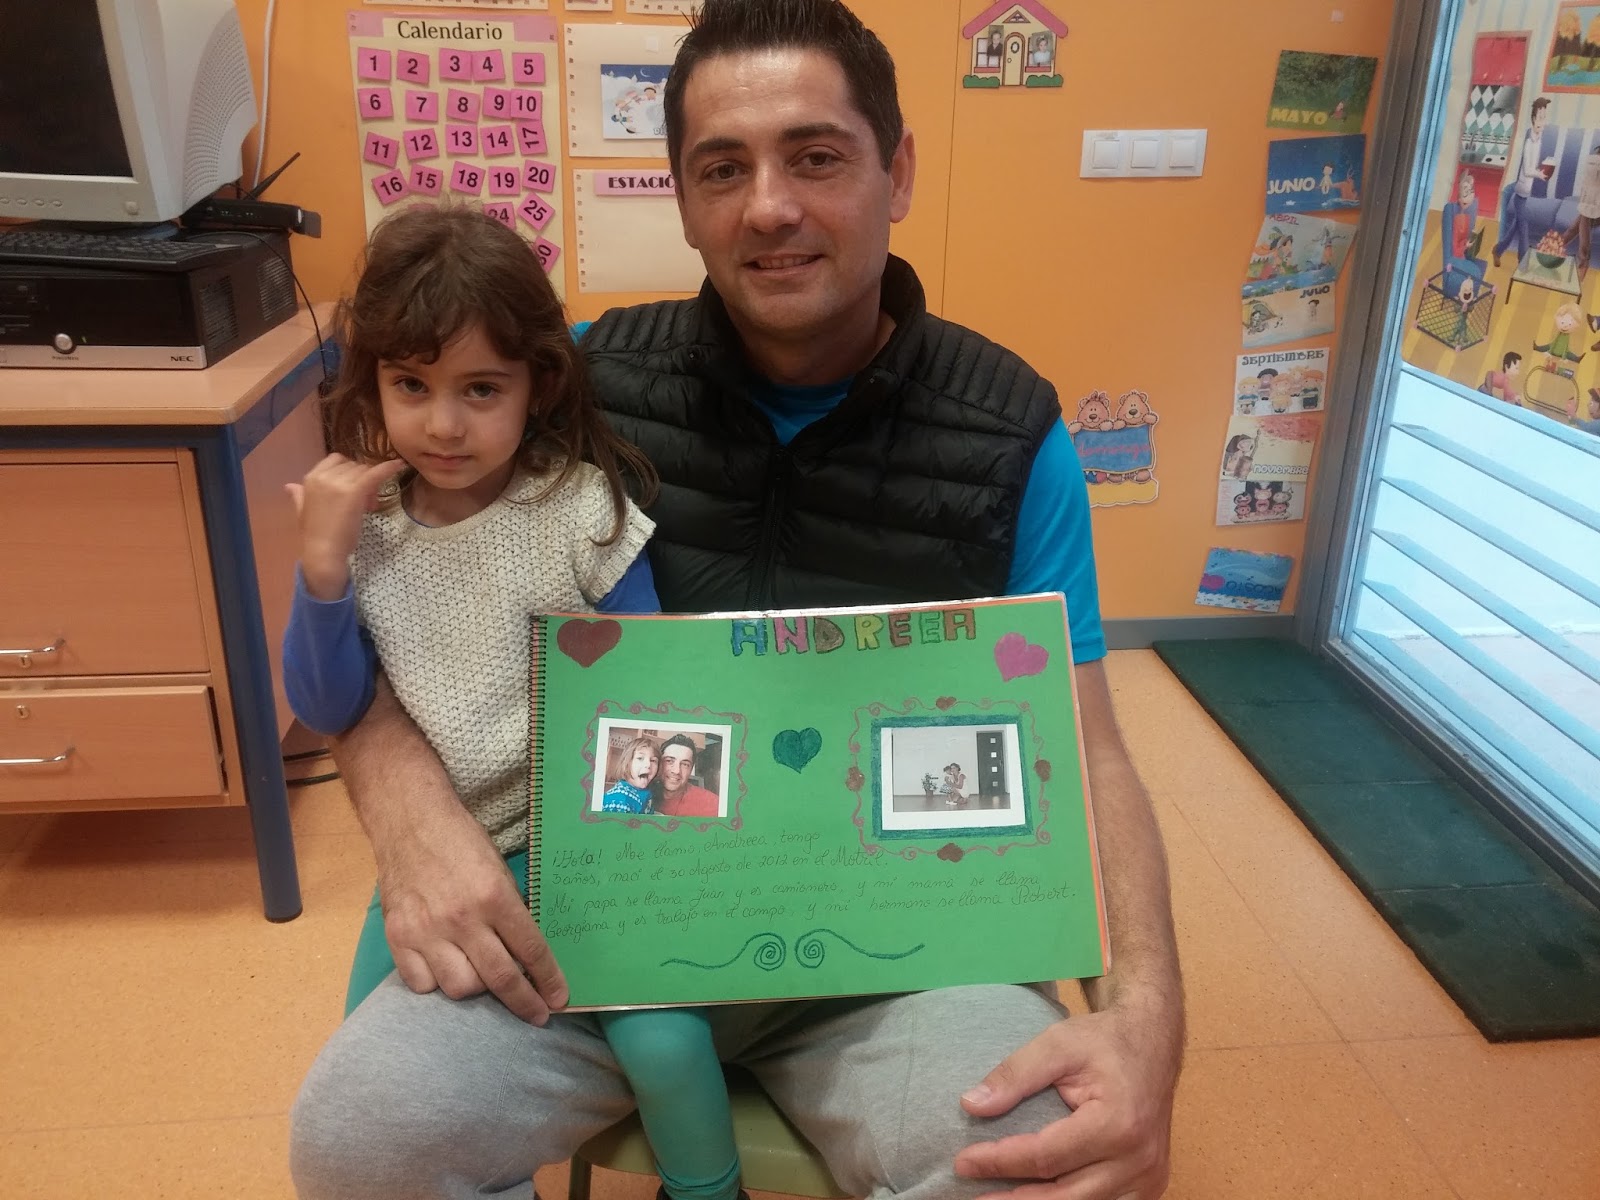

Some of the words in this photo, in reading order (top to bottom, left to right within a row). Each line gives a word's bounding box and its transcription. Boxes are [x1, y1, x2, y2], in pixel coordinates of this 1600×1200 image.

[397, 20, 503, 41] Calendario
[369, 55, 378, 71] 1
[407, 58, 418, 75] 2
[449, 55, 461, 72] 3
[482, 56, 494, 73] 4
[523, 59, 534, 76] 5
[369, 94, 381, 110] 6
[416, 97, 427, 113] 7
[457, 96, 469, 113] 8
[493, 95, 505, 111] 9
[516, 96, 537, 112] 10
[1271, 108, 1328, 125] MAYO
[371, 140, 390, 159] 11
[410, 134, 433, 152] 12
[451, 131, 472, 147] 13
[487, 132, 509, 148] 14
[521, 127, 540, 149] 17
[380, 177, 403, 196] 16
[416, 171, 437, 189] 15
[458, 170, 479, 188] 18
[494, 172, 515, 188] 19
[527, 167, 550, 185] 20
[1267, 177, 1316, 195] JUNIO
[523, 199, 548, 222] 25
[1300, 285, 1331, 299] JULIO
[731, 608, 977, 656] ANDREEA
[780, 830, 820, 854] tengo
[670, 868, 685, 879] 30
[736, 854, 752, 871] de
[758, 855, 788, 867] 2012
[793, 856, 809, 866] en
[625, 896, 639, 908] se
[644, 890, 683, 907] llama
[735, 888, 744, 906] y
[855, 880, 866, 897] y
[969, 876, 985, 887] se
[995, 870, 1041, 886] llama
[617, 921, 626, 937] y
[703, 909, 718, 918] en
[804, 902, 817, 920] y
[937, 897, 953, 909] se
[958, 890, 1004, 906] llama
